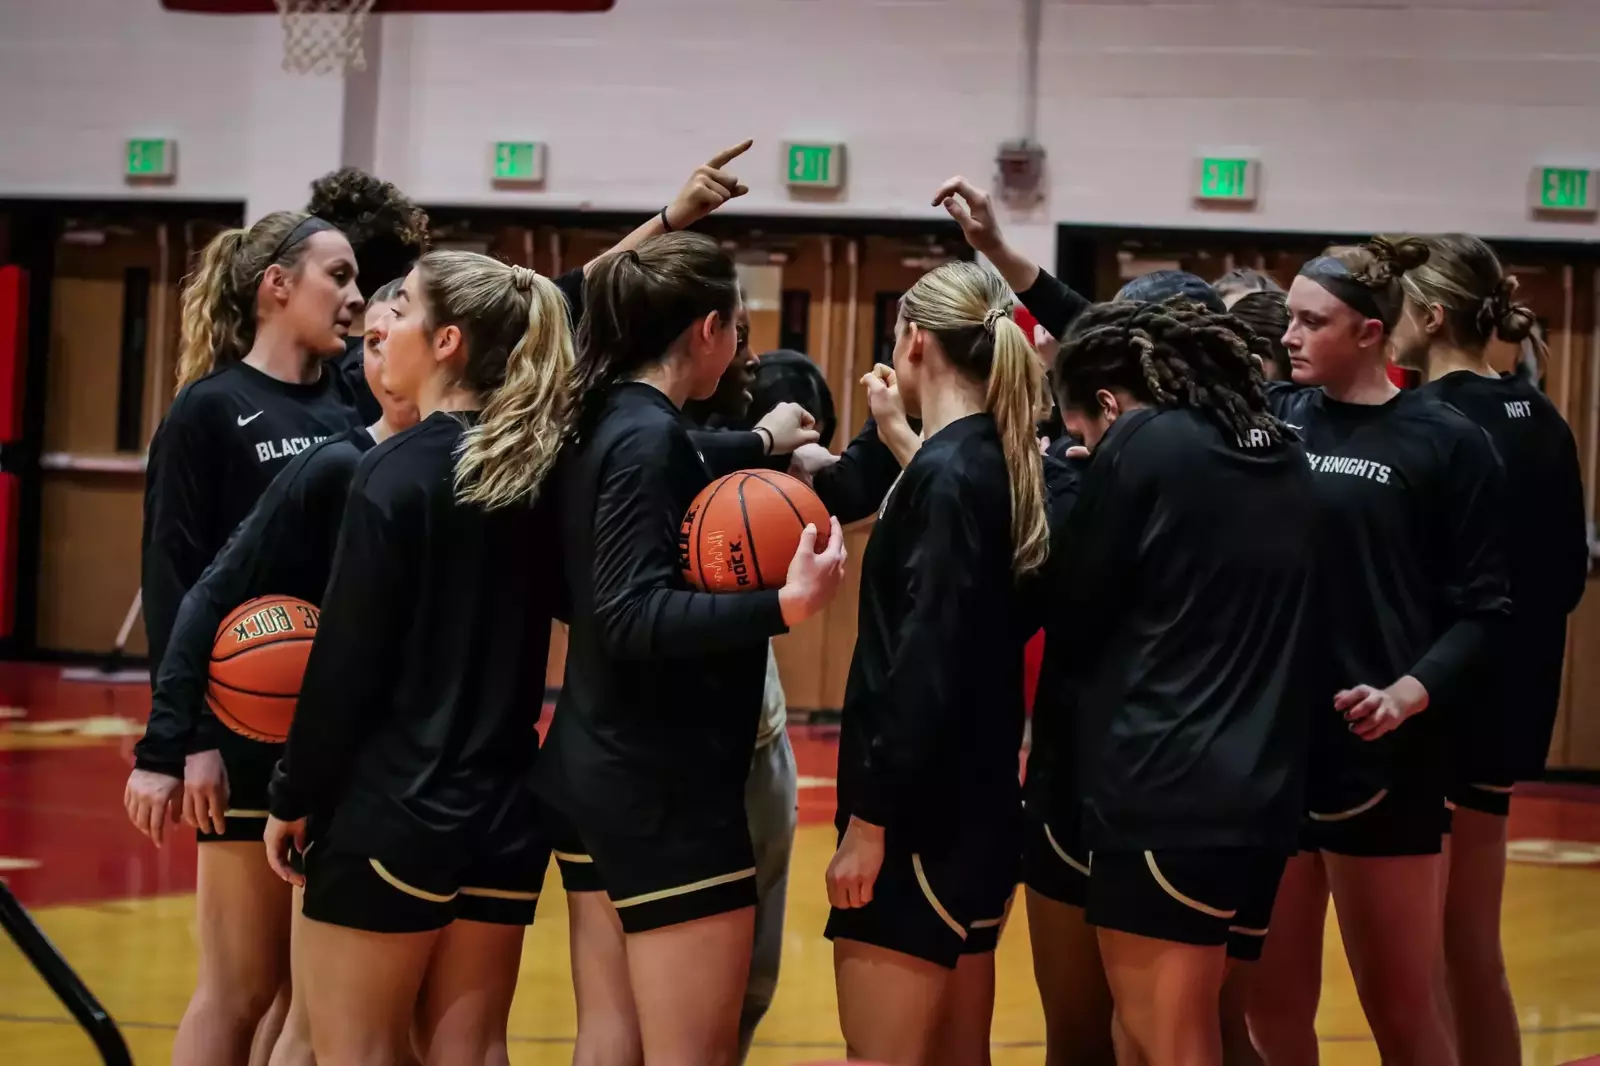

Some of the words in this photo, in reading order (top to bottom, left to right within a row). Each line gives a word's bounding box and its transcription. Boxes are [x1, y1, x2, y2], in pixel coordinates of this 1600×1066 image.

[1202, 158, 1247, 197] EXIT
[1541, 168, 1590, 207] EXIT
[1504, 400, 1531, 418] NRT
[1319, 455, 1391, 484] KNIGHTS
[729, 541, 750, 586] ROCK
[232, 605, 295, 643] ROCK
